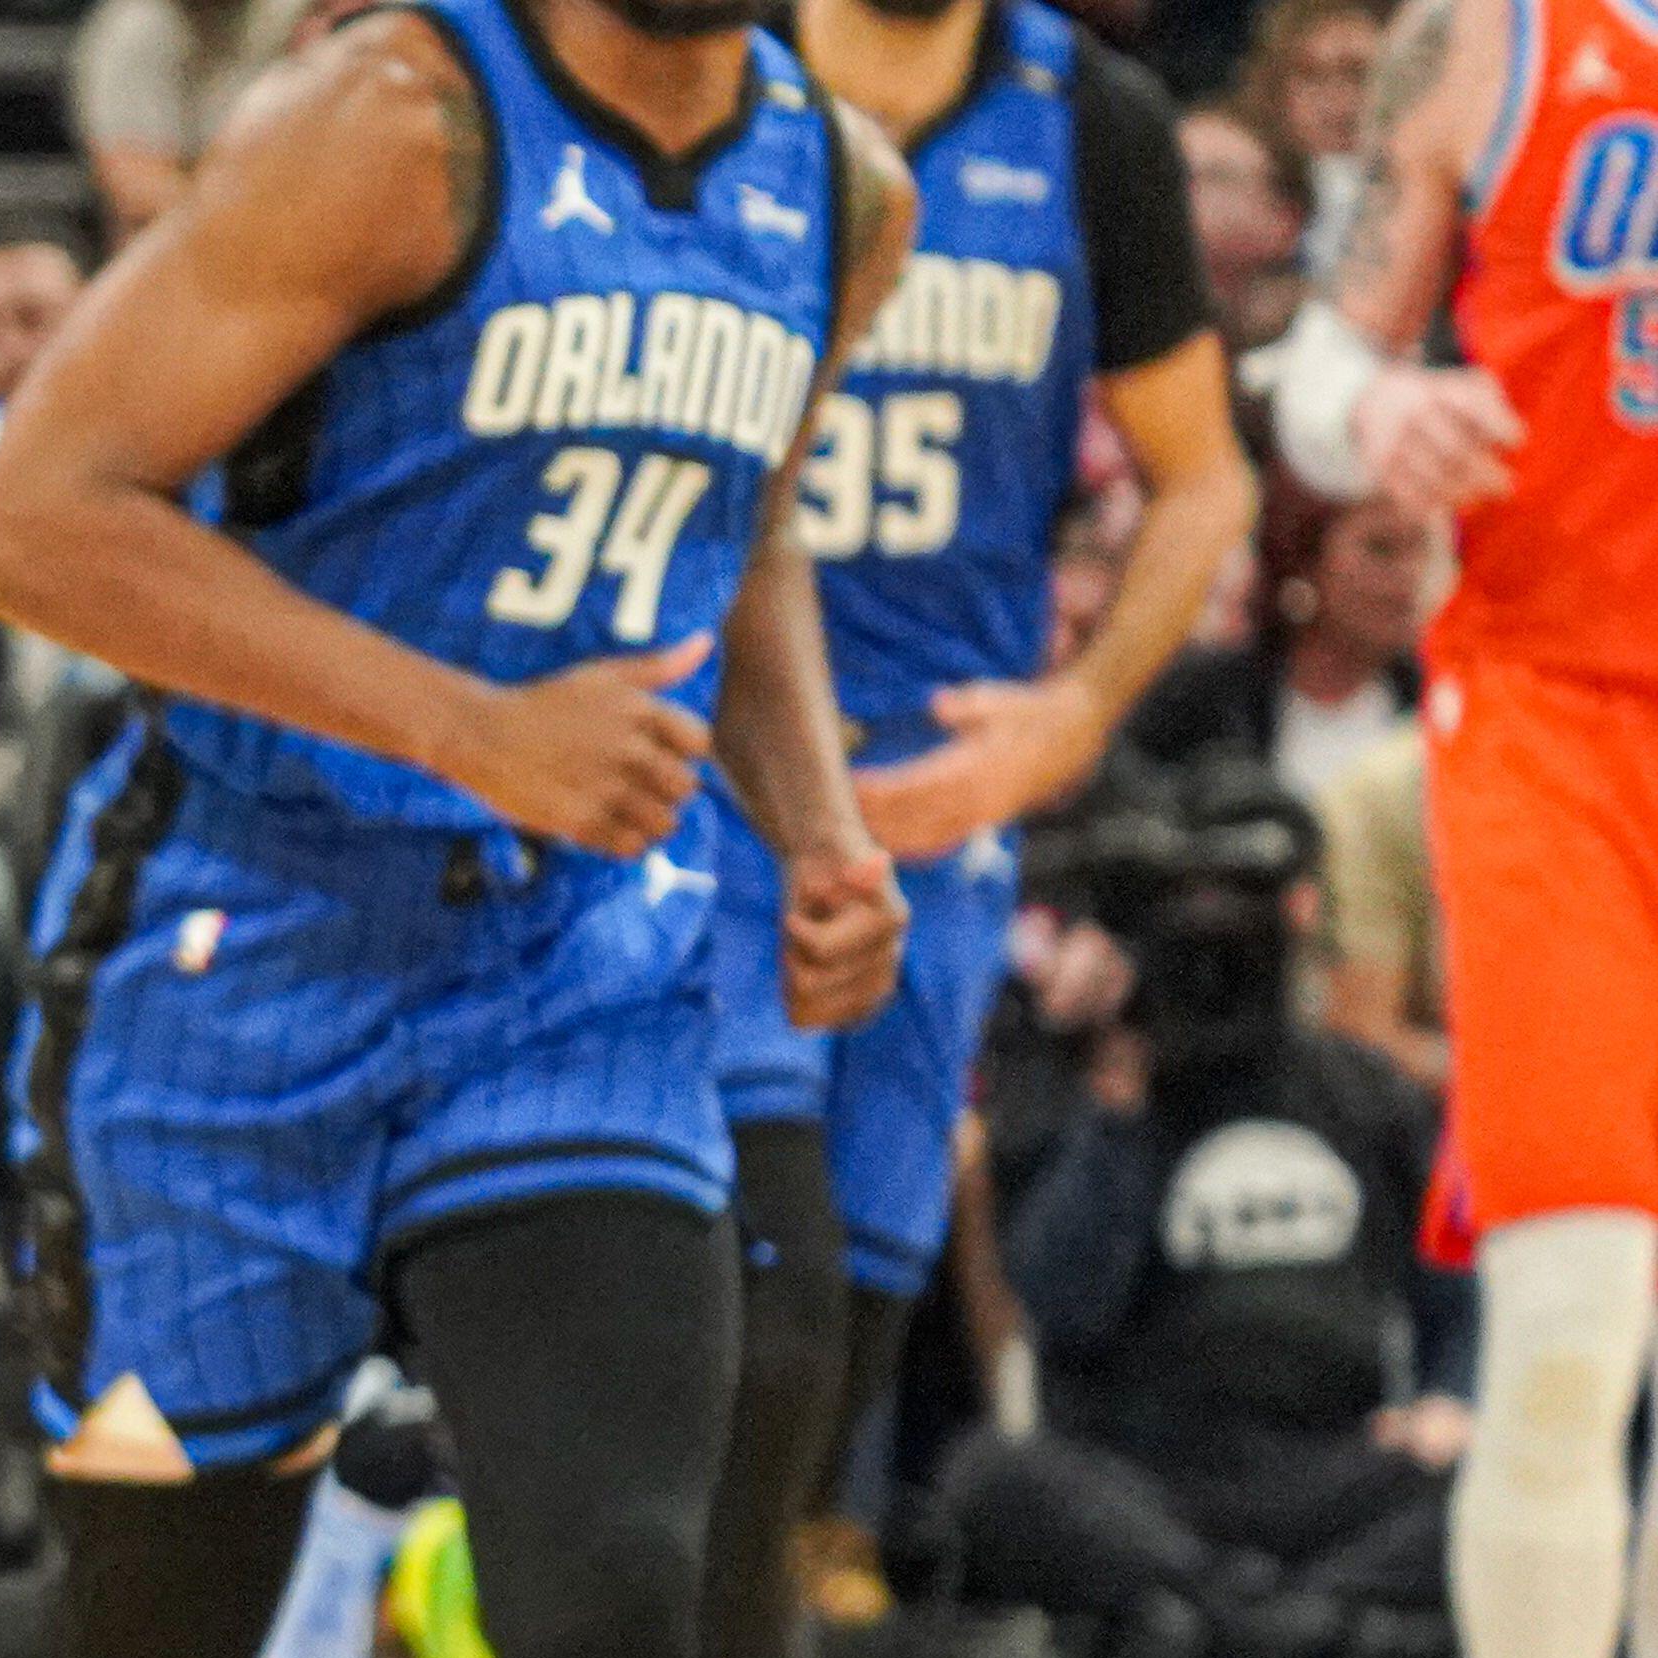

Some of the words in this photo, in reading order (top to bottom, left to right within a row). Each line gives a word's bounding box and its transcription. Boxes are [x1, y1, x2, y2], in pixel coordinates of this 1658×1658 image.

[1547, 108, 1658, 298] O
[485, 444, 712, 646] 34
[795, 390, 964, 562] 35
